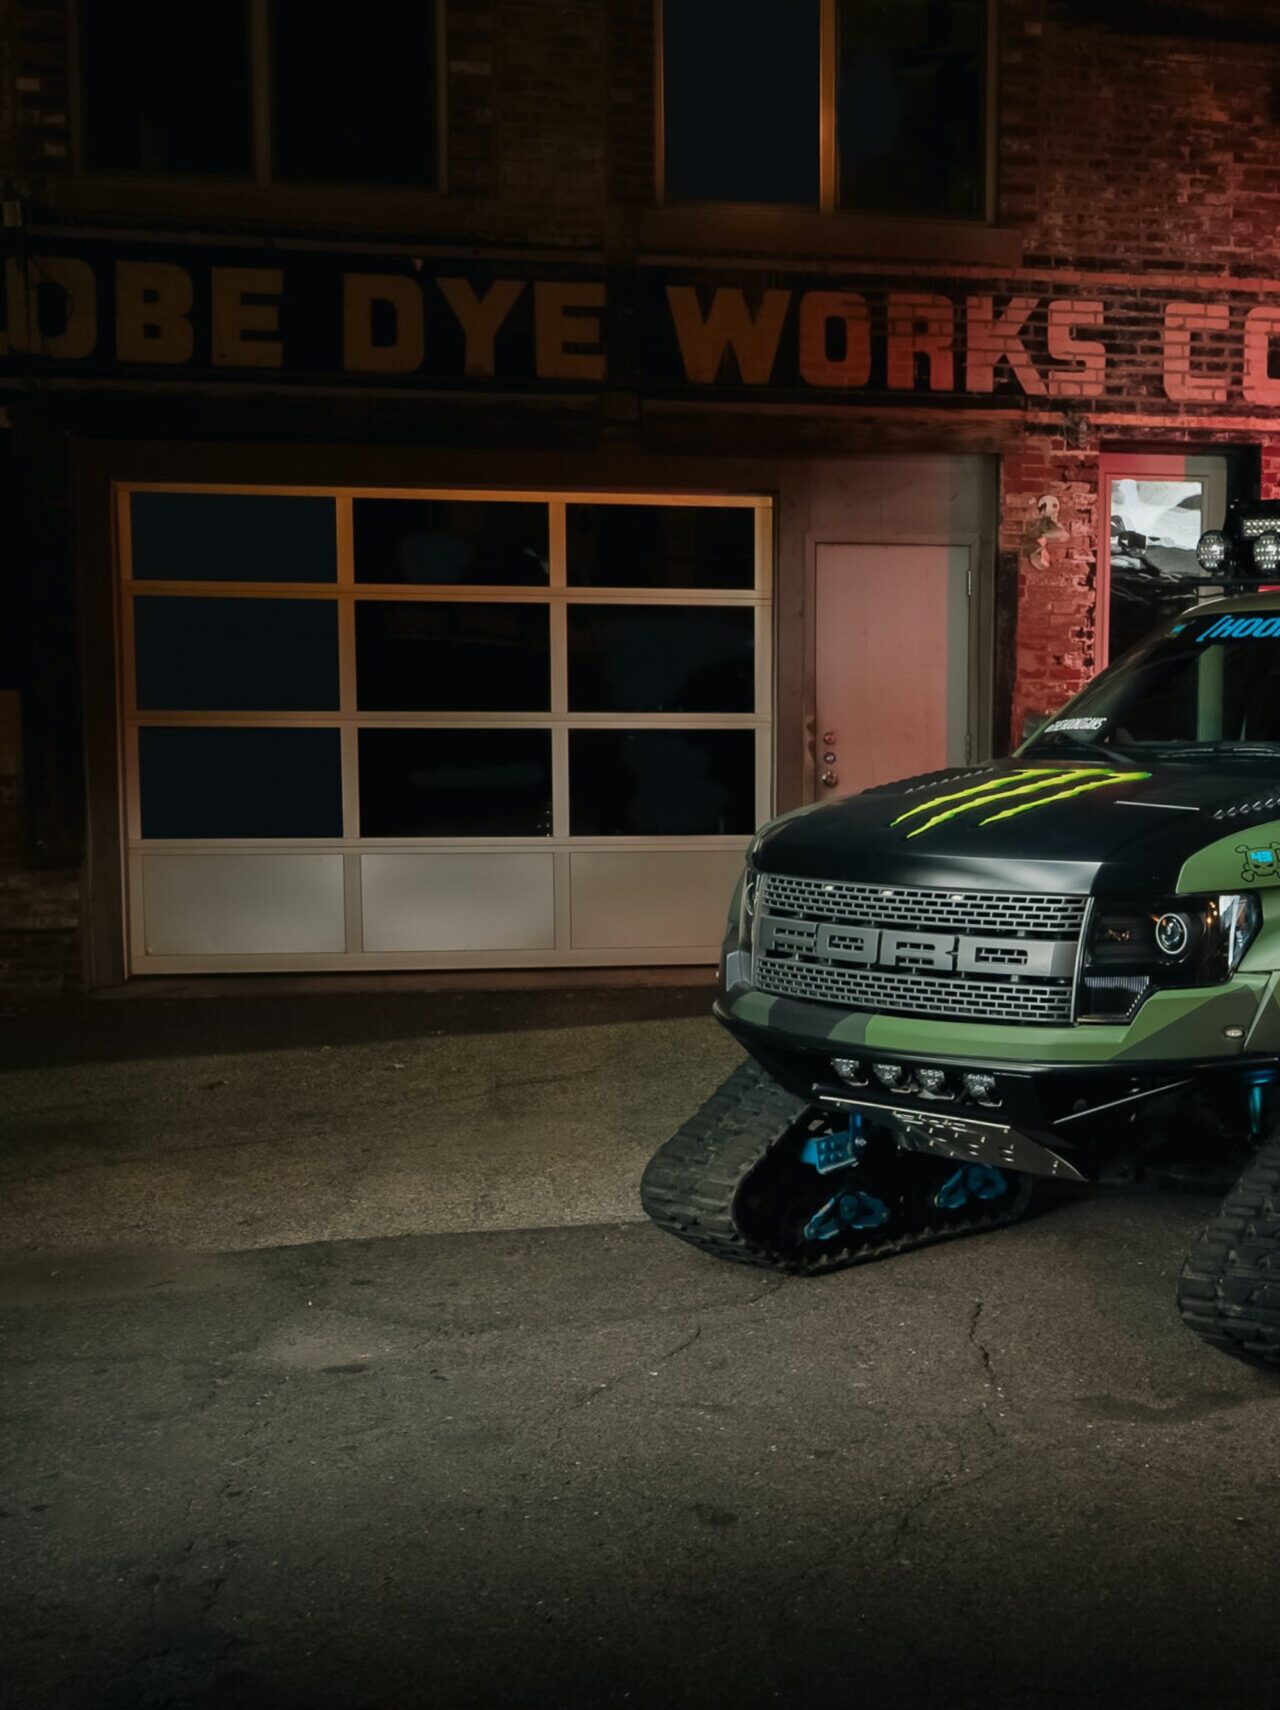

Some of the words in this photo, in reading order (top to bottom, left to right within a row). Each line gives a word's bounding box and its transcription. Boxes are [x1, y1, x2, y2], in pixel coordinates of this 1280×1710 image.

[0, 255, 284, 368] OBE
[342, 273, 607, 380] DYE
[666, 285, 1106, 397] WORKS
[758, 915, 1078, 977] FORD
